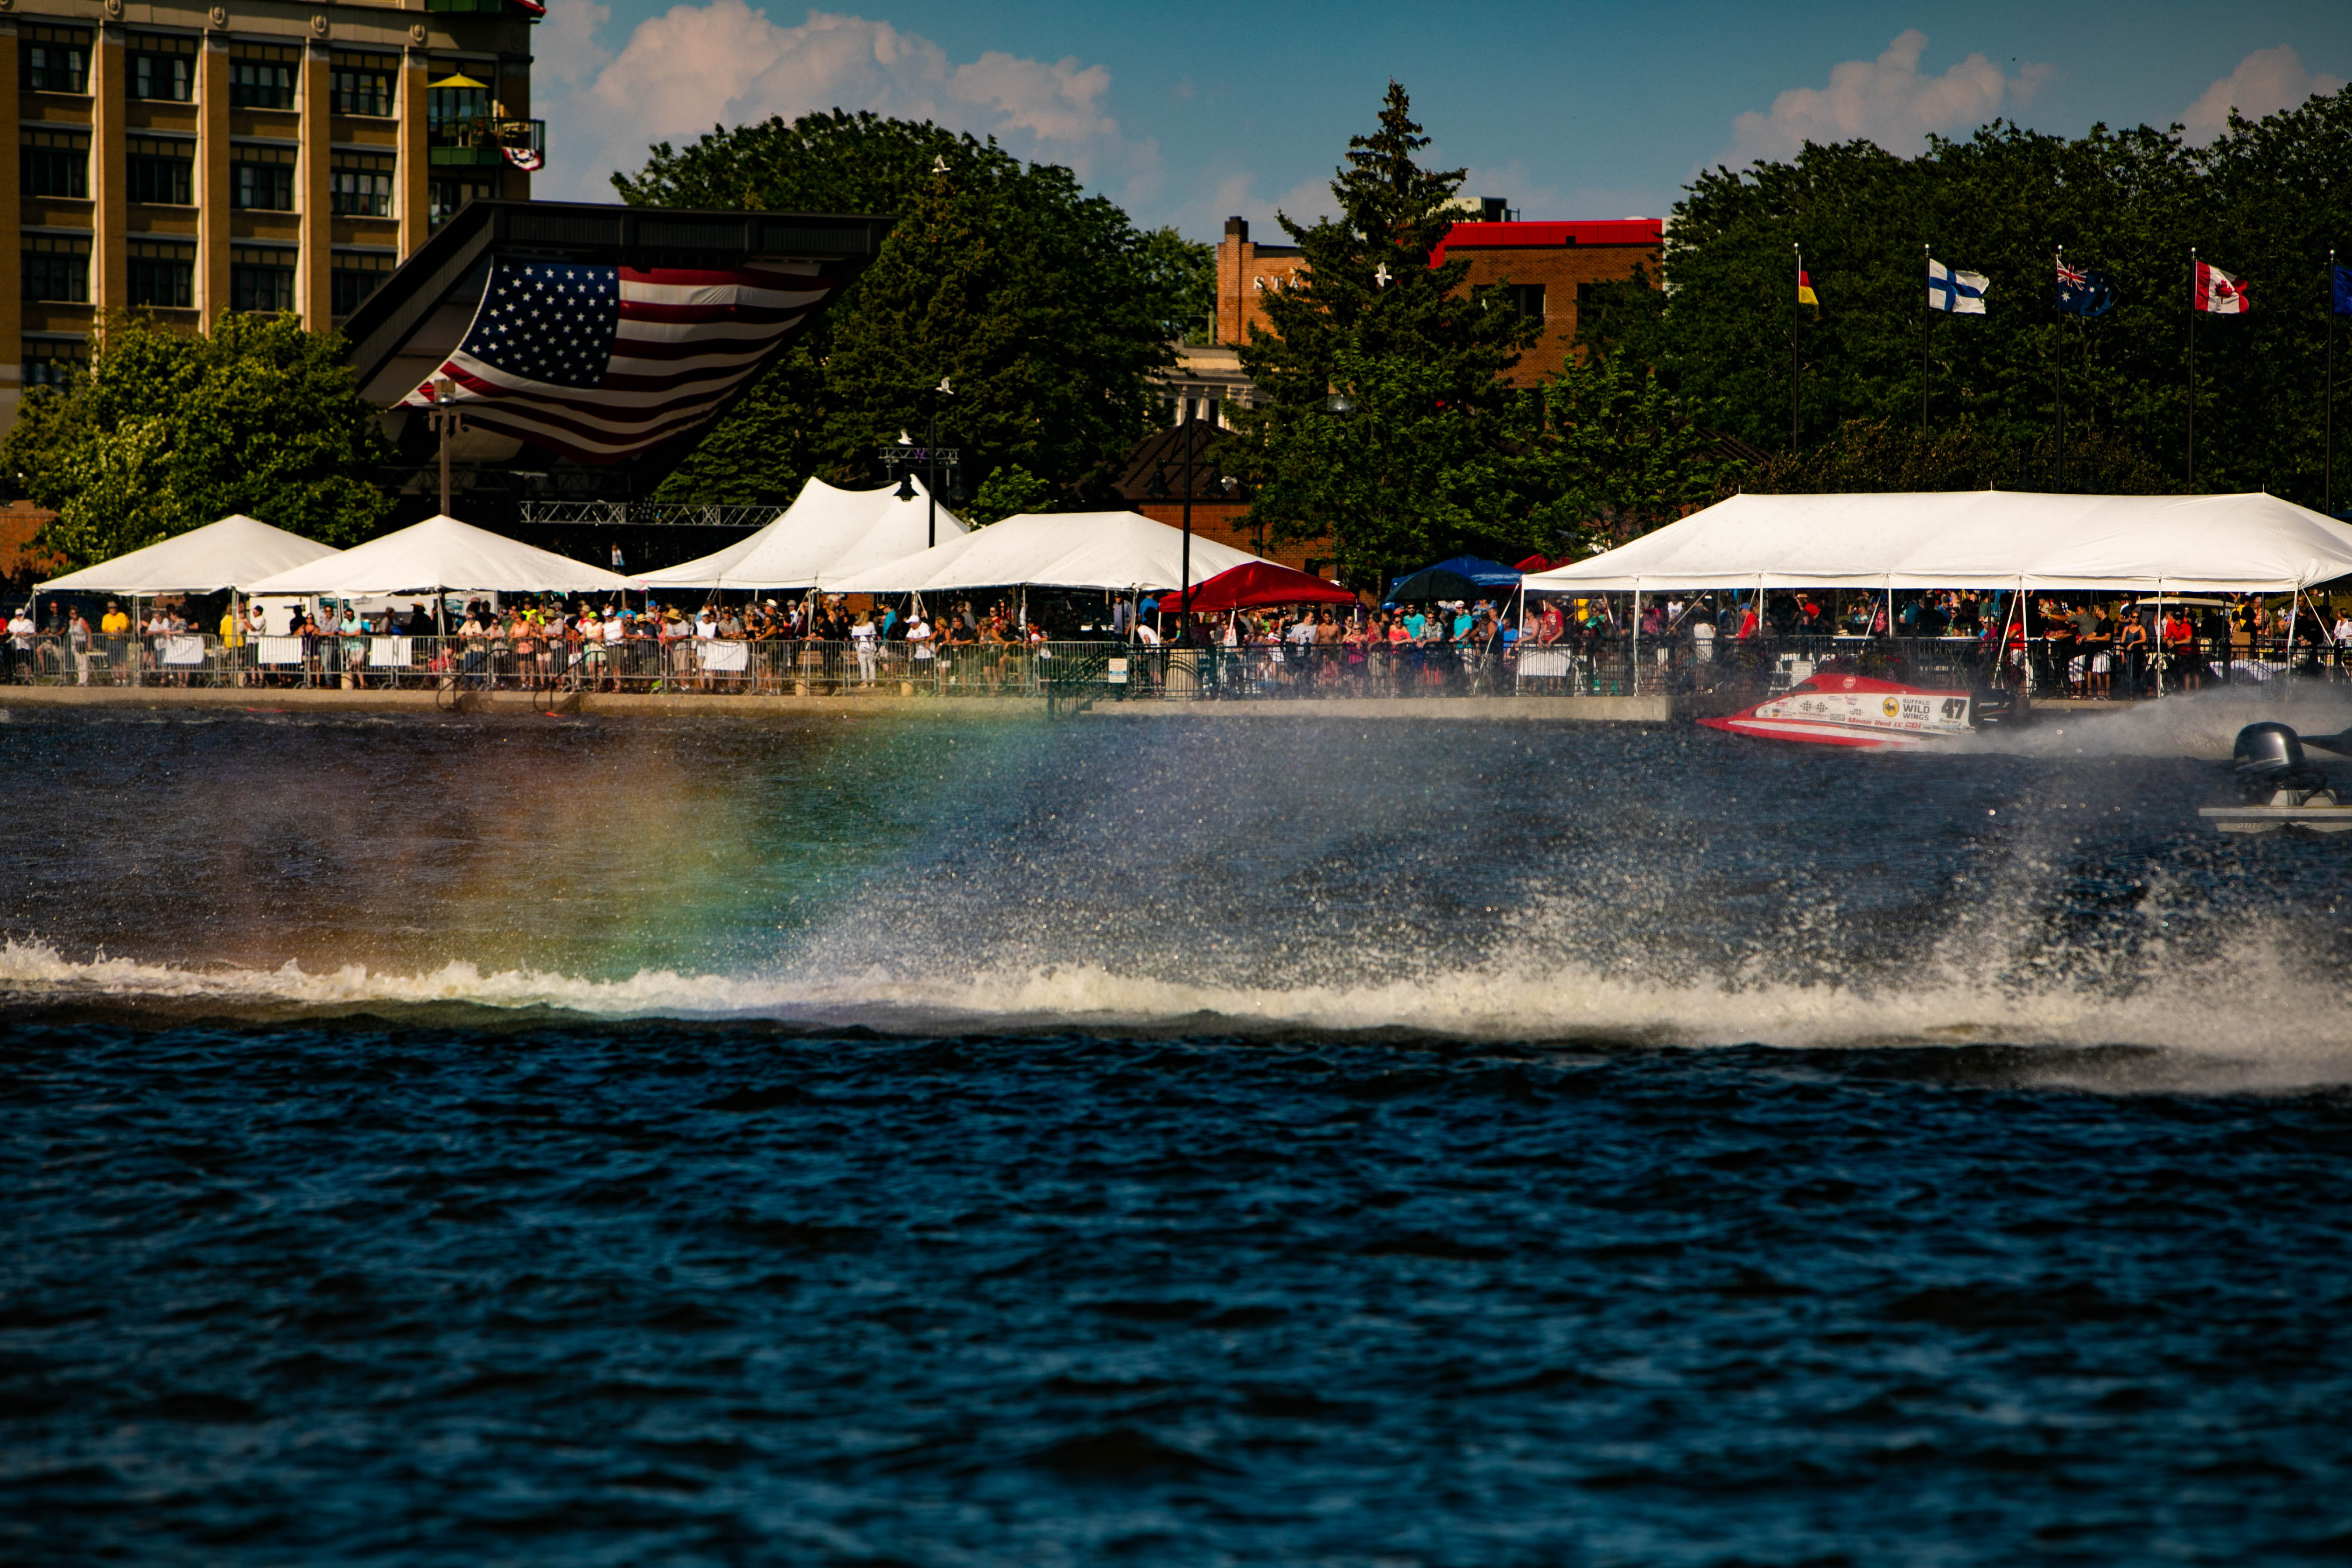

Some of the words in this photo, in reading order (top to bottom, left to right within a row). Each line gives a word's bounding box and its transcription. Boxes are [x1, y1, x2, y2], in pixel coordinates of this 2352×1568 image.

[1903, 704, 1930, 714] WILD
[1941, 698, 1967, 720] 47
[1903, 713, 1929, 721] WINGS
